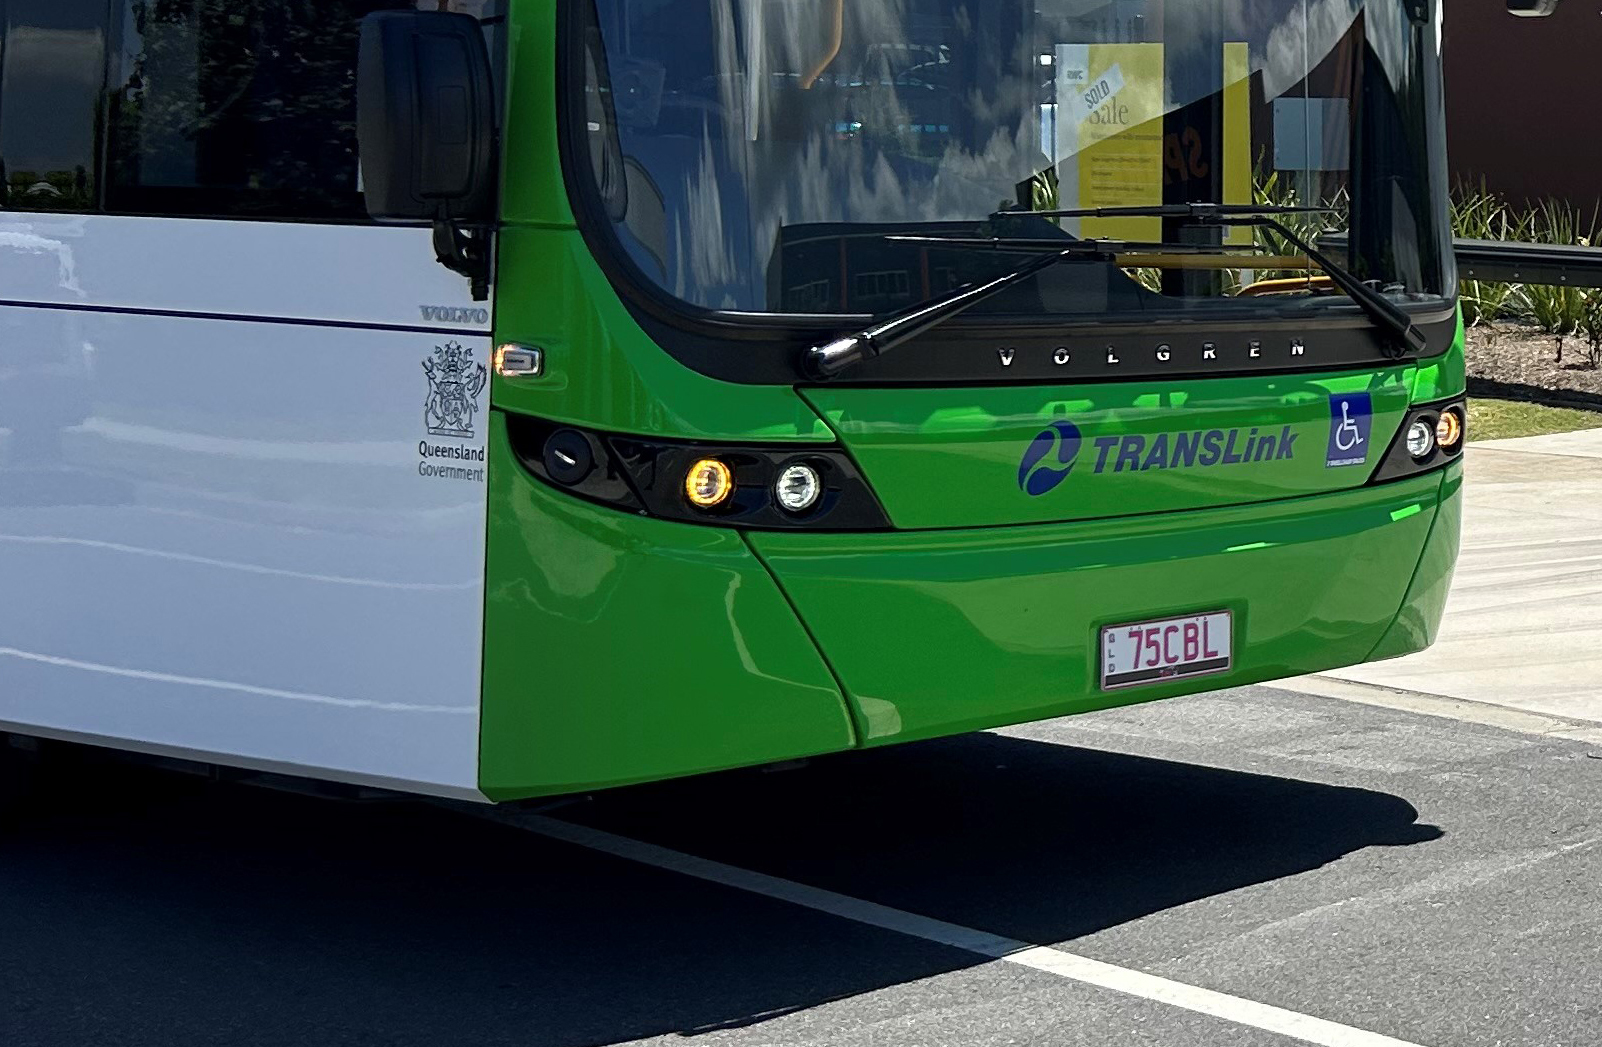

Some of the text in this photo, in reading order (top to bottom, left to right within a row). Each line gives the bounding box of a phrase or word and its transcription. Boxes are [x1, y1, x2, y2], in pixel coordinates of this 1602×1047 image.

[1084, 79, 1110, 110] SOLD
[419, 305, 489, 324] VOLVO
[999, 339, 1305, 367] VOLGREN
[418, 440, 485, 462] Queensland
[1093, 425, 1299, 474] TRANSLink
[418, 461, 484, 483] Government
[1128, 620, 1219, 670] 75CBL
